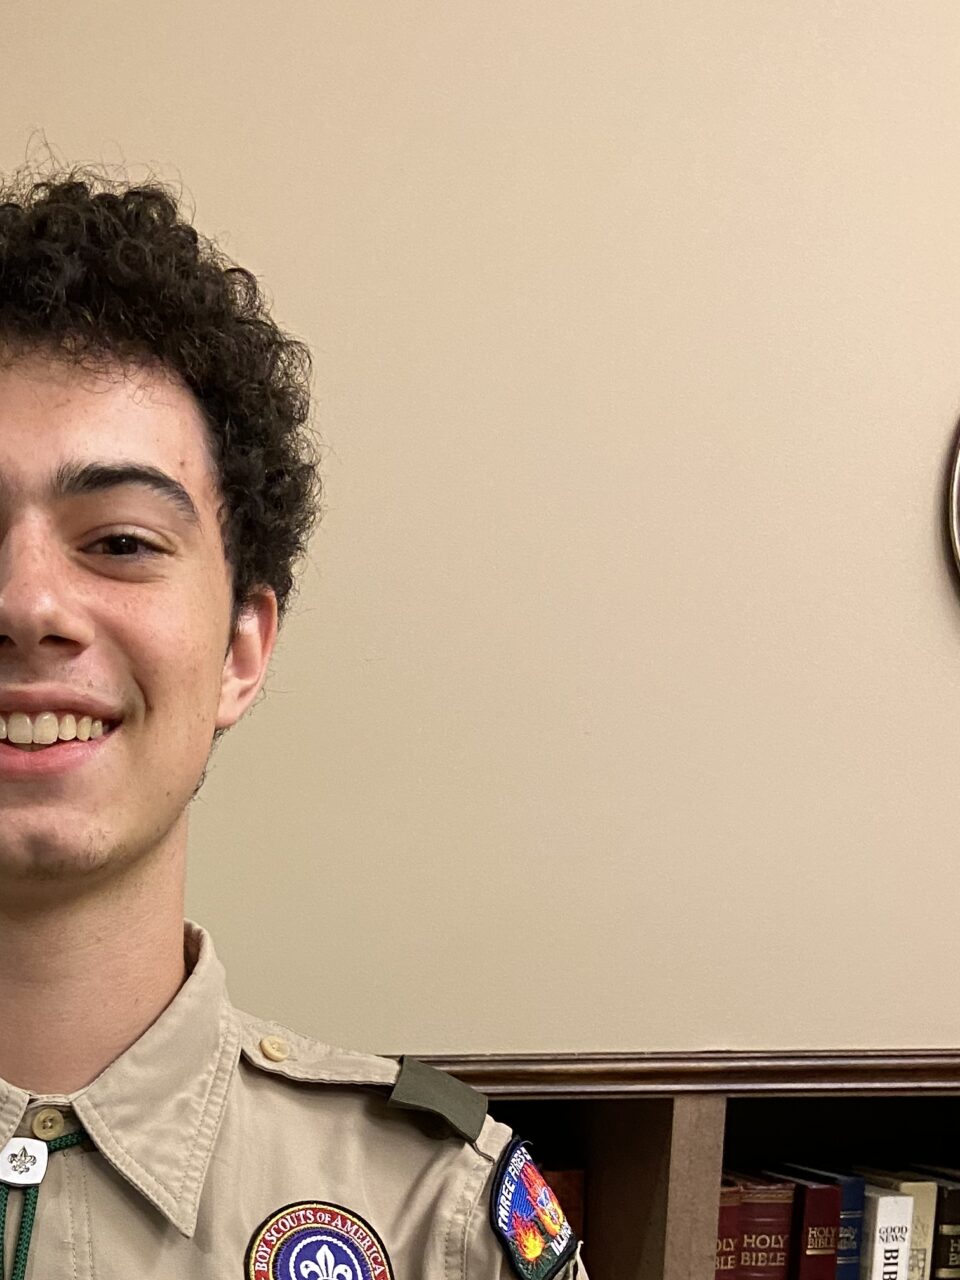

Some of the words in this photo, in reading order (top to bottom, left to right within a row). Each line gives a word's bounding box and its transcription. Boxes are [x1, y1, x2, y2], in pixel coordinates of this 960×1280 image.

[498, 1177, 515, 1231] THREE
[808, 1226, 837, 1238] HOLY
[879, 1225, 908, 1234] GOOD
[255, 1243, 272, 1272] BOY
[265, 1209, 314, 1244] SCOUTS
[316, 1211, 331, 1224] OF
[332, 1215, 384, 1277] AMERICA
[743, 1234, 788, 1249] HOLY
[807, 1238, 835, 1249] BIBLE
[880, 1234, 907, 1243] NEWS
[741, 1252, 787, 1266] BIBLE
